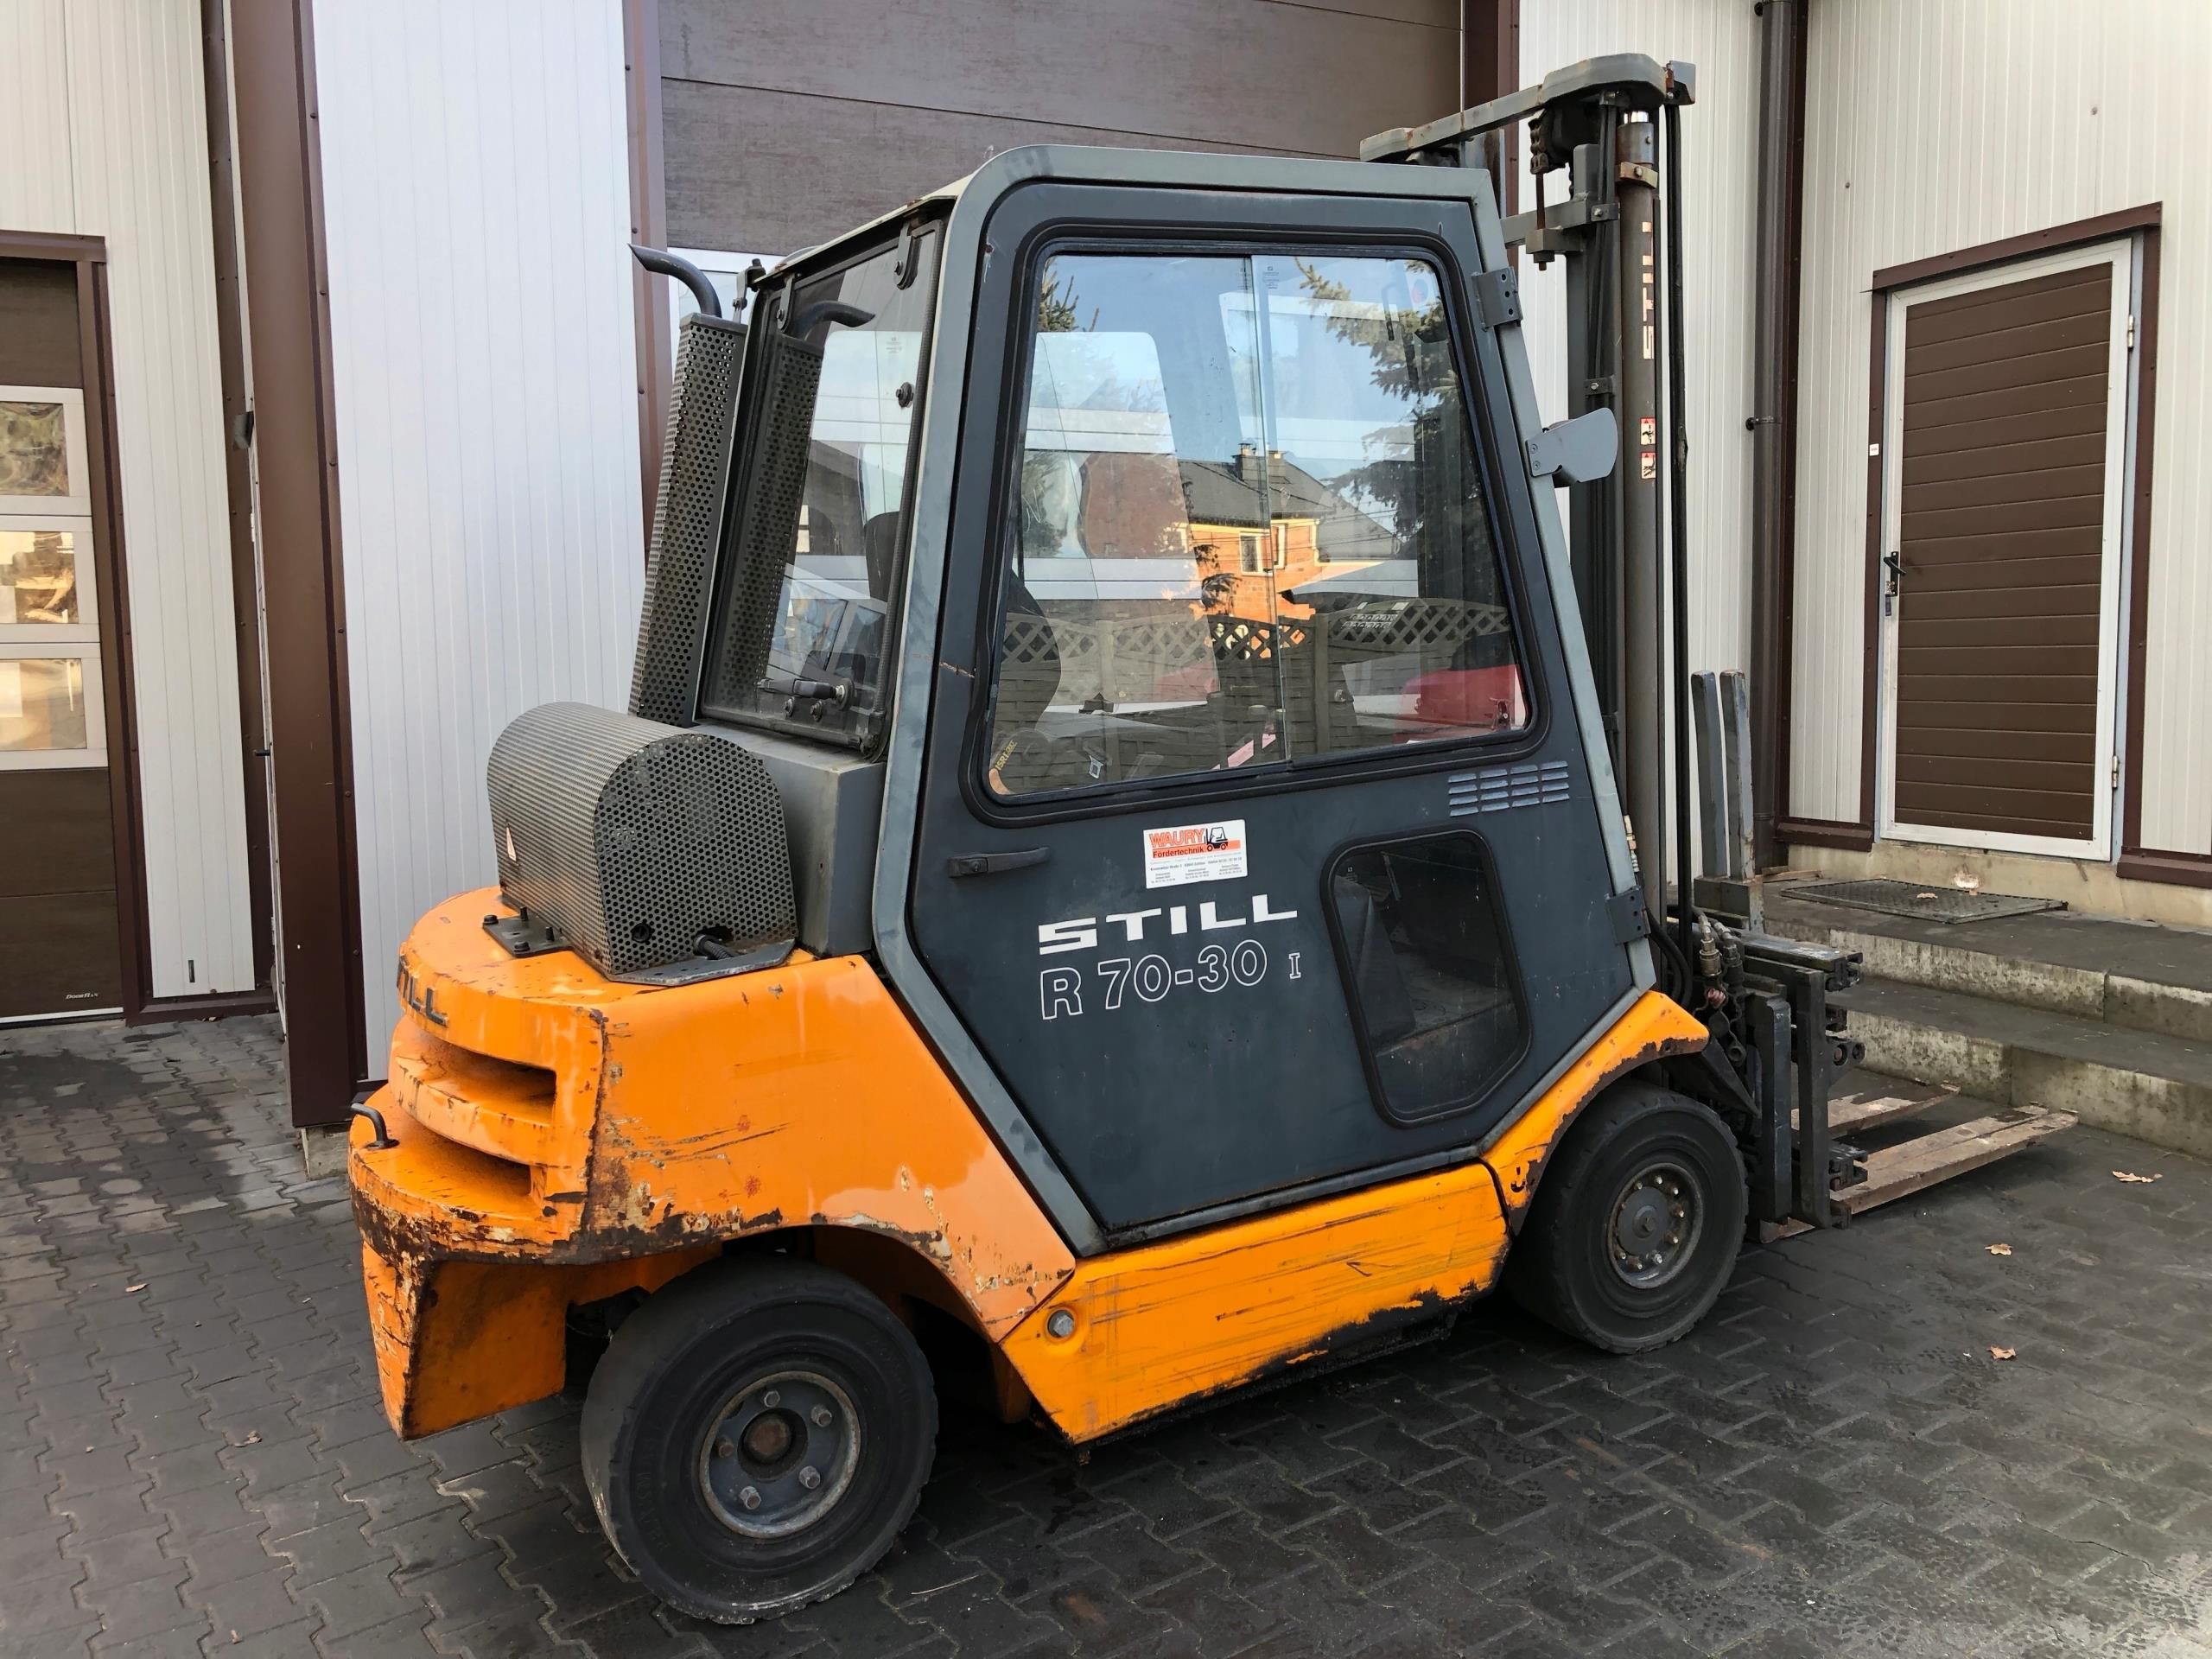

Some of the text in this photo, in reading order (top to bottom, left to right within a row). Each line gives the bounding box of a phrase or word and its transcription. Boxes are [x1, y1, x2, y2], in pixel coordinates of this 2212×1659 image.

[1149, 829, 1205, 847] WAURY
[1039, 894, 1297, 955] STILL
[1040, 967, 1083, 1020] R
[1097, 939, 1267, 1009] 70-30
